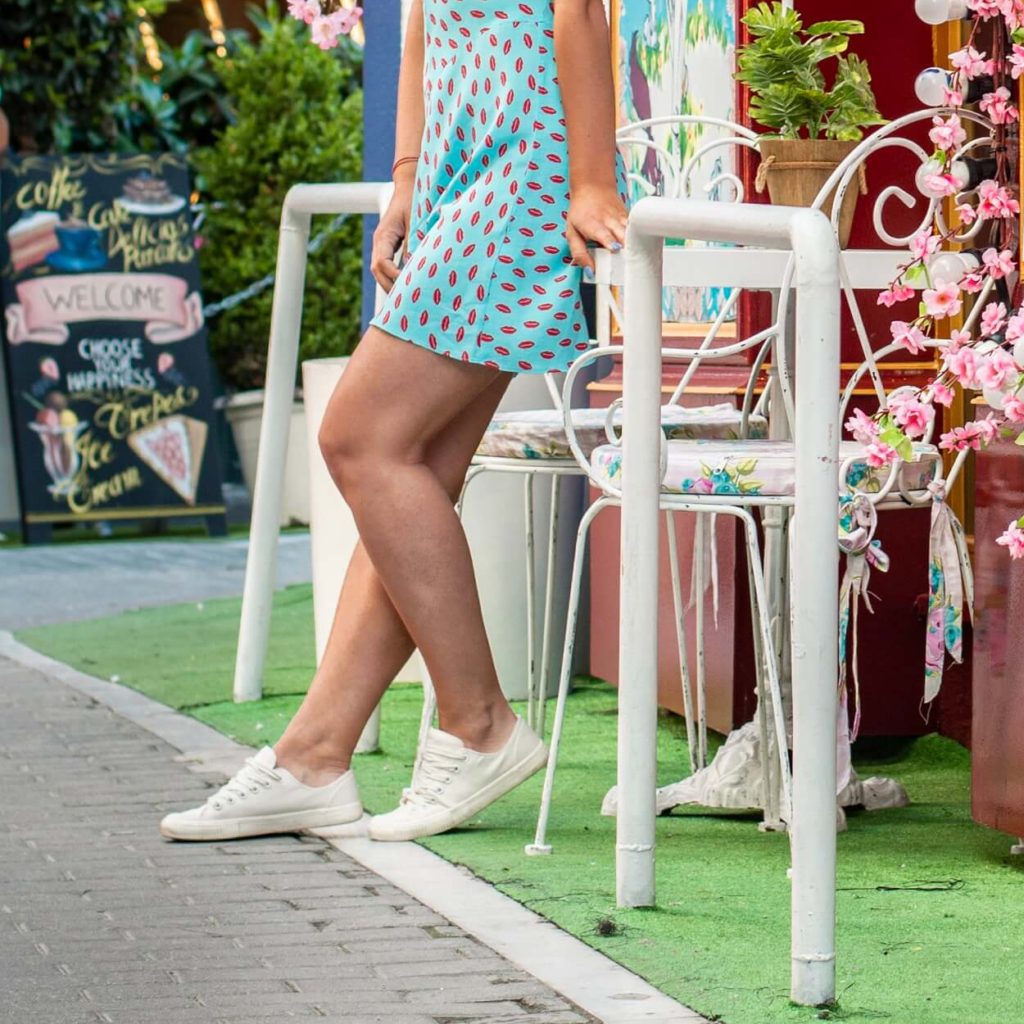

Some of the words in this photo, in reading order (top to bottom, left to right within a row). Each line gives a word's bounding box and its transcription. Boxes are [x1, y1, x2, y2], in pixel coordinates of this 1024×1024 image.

[42, 282, 167, 312] WELCOME
[78, 338, 143, 360] CHOOSE
[66, 368, 156, 392] HAPPINESS
